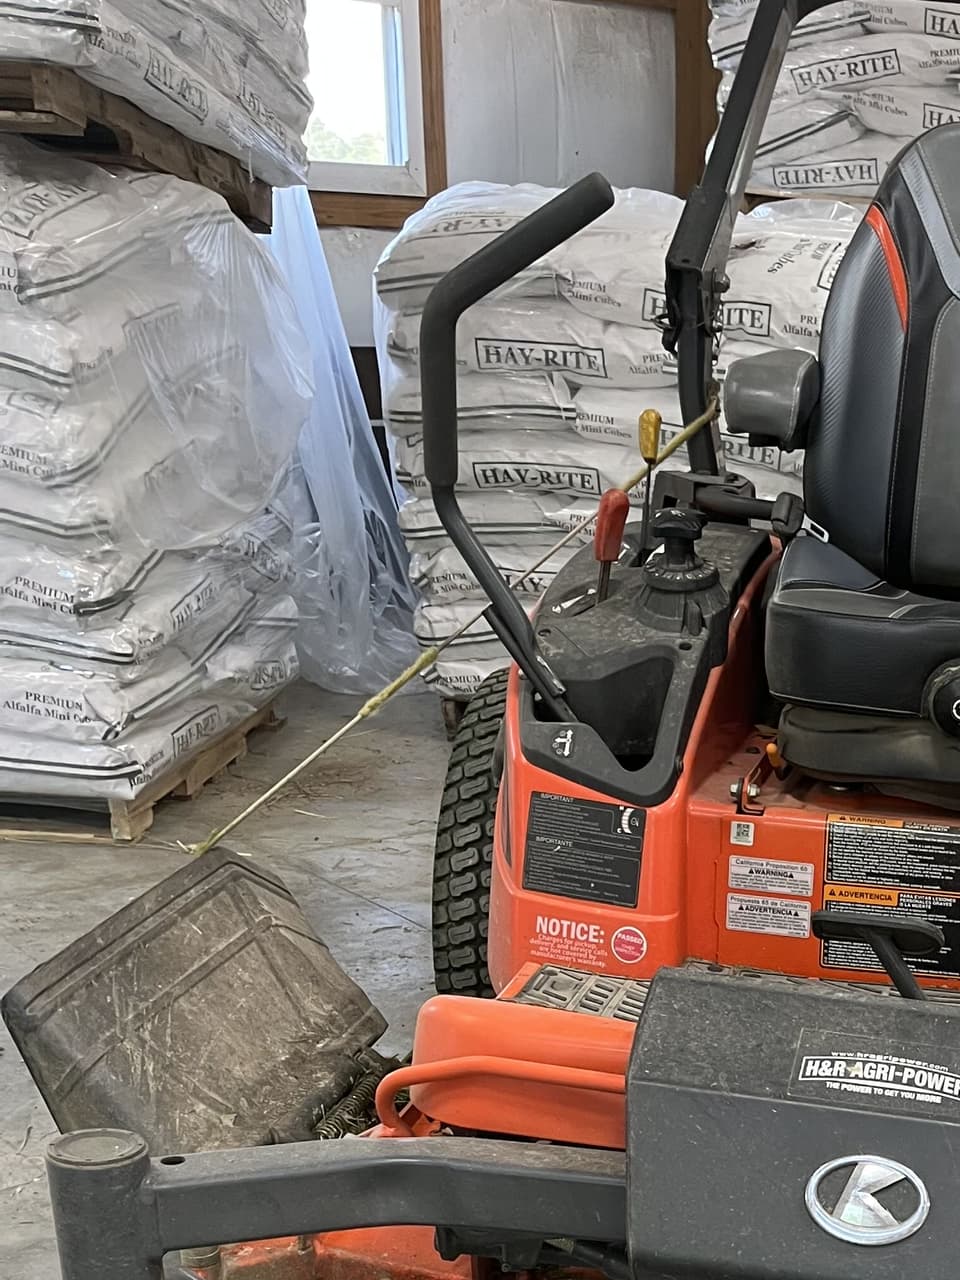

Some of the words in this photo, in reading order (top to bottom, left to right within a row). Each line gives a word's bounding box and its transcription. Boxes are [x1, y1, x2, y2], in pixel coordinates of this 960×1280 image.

[799, 56, 895, 87] HAY-RITE
[778, 164, 873, 184] HAY-RITE
[783, 325, 813, 337] Alfalfa
[484, 344, 601, 372] HAY-RITE
[604, 426, 632, 439] Cubes
[481, 468, 595, 491] HAY-RITE
[15, 576, 74, 604] PREMIUM
[3, 700, 41, 716] Alfalfa
[45, 707, 70, 721] Mini
[754, 869, 788, 878] WARNING
[838, 890, 893, 901] ADVERTENCIA
[745, 905, 793, 916] ADVERTENCIA
[536, 915, 605, 944] NOTICE:
[538, 934, 563, 944] Charges
[557, 942, 569, 950] and
[805, 1060, 846, 1077] H&R
[831, 1051, 949, 1072] www.hragripower.com
[841, 1083, 873, 1095] POWER
[874, 1087, 884, 1095] TO
[884, 1089, 898, 1097] GET
[901, 1091, 916, 1100] YOU
[916, 1093, 942, 1104] MORE
